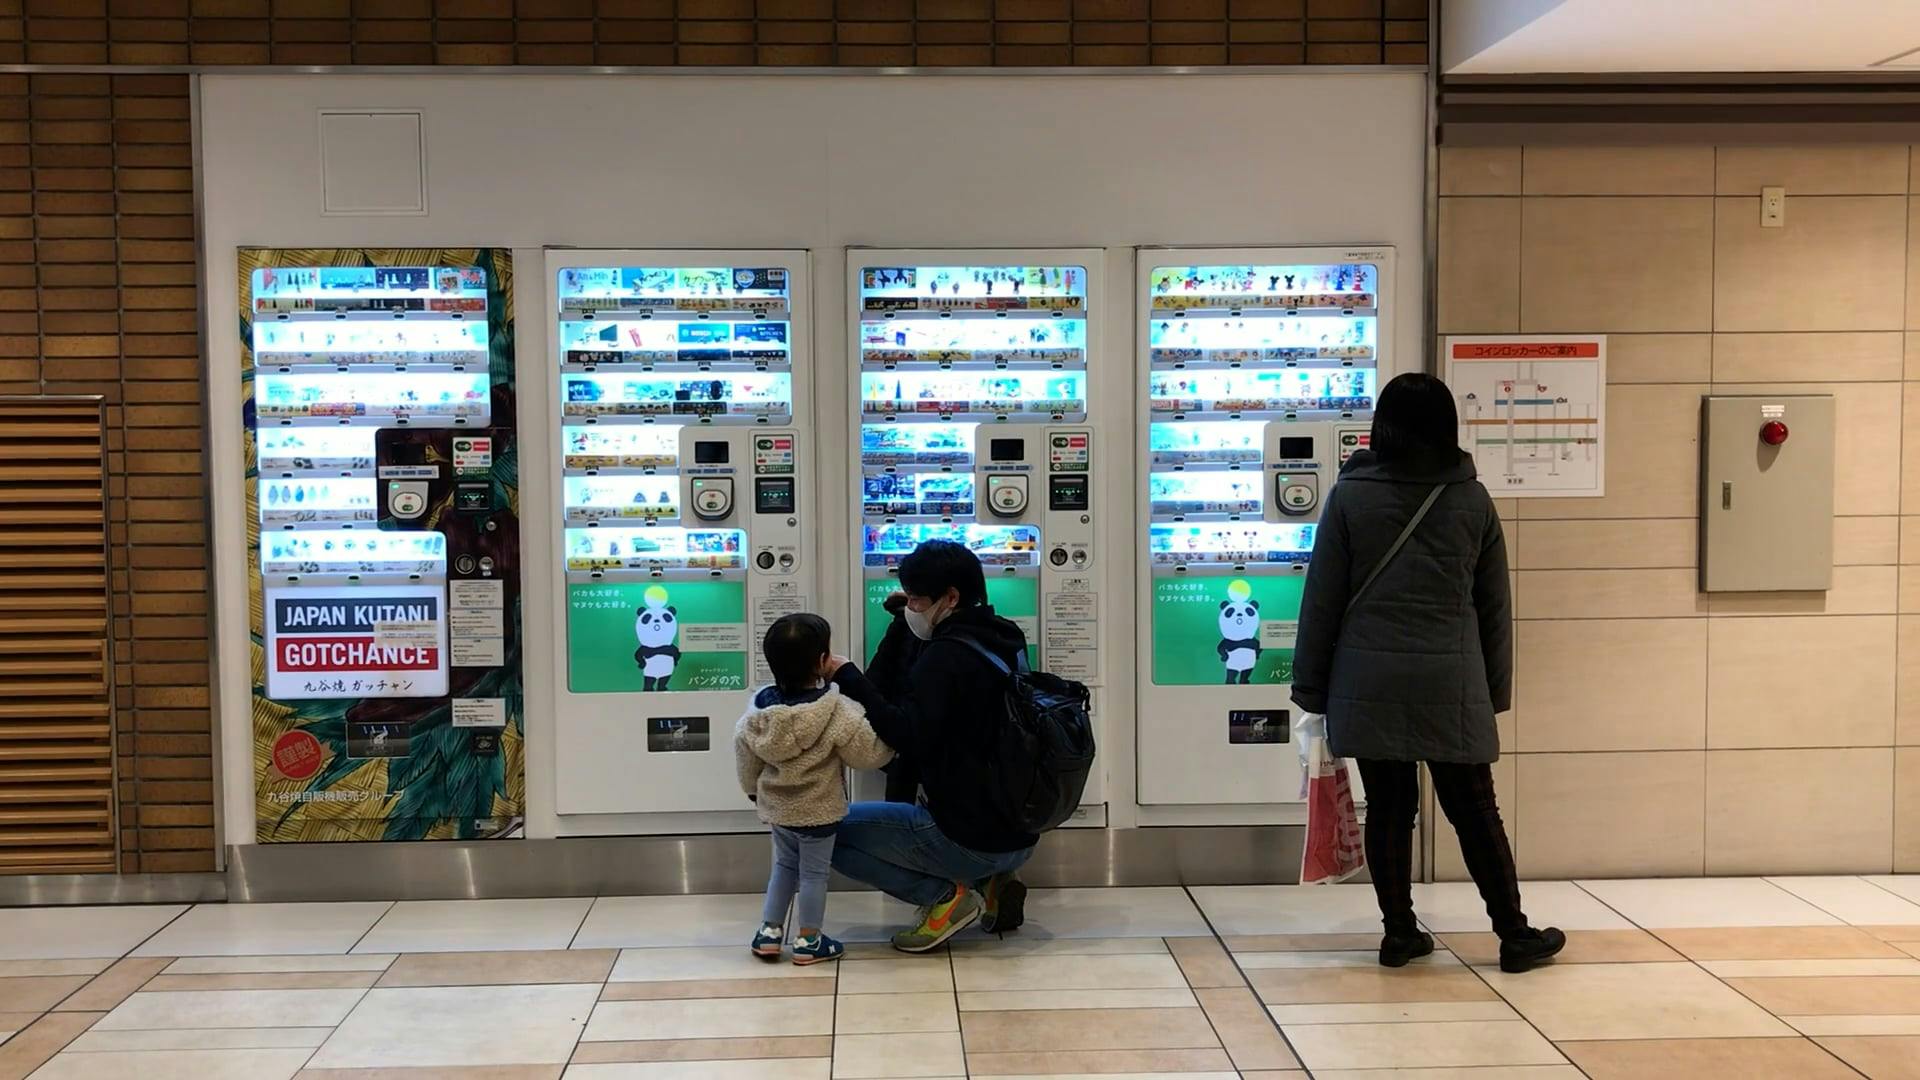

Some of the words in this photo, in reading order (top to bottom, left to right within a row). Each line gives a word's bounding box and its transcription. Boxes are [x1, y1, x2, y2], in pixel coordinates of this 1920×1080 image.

[1474, 346, 1577, 356] コインロッカーのご案内
[284, 606, 346, 626] JAPAN
[354, 605, 429, 625] KUTANI
[285, 642, 430, 666] GOTCHANCE
[303, 680, 346, 692] 九谷焼
[352, 679, 414, 691] ガッチャン
[688, 675, 741, 686] パンダの穴
[267, 790, 405, 804] 九谷焼自販機販売グループ
